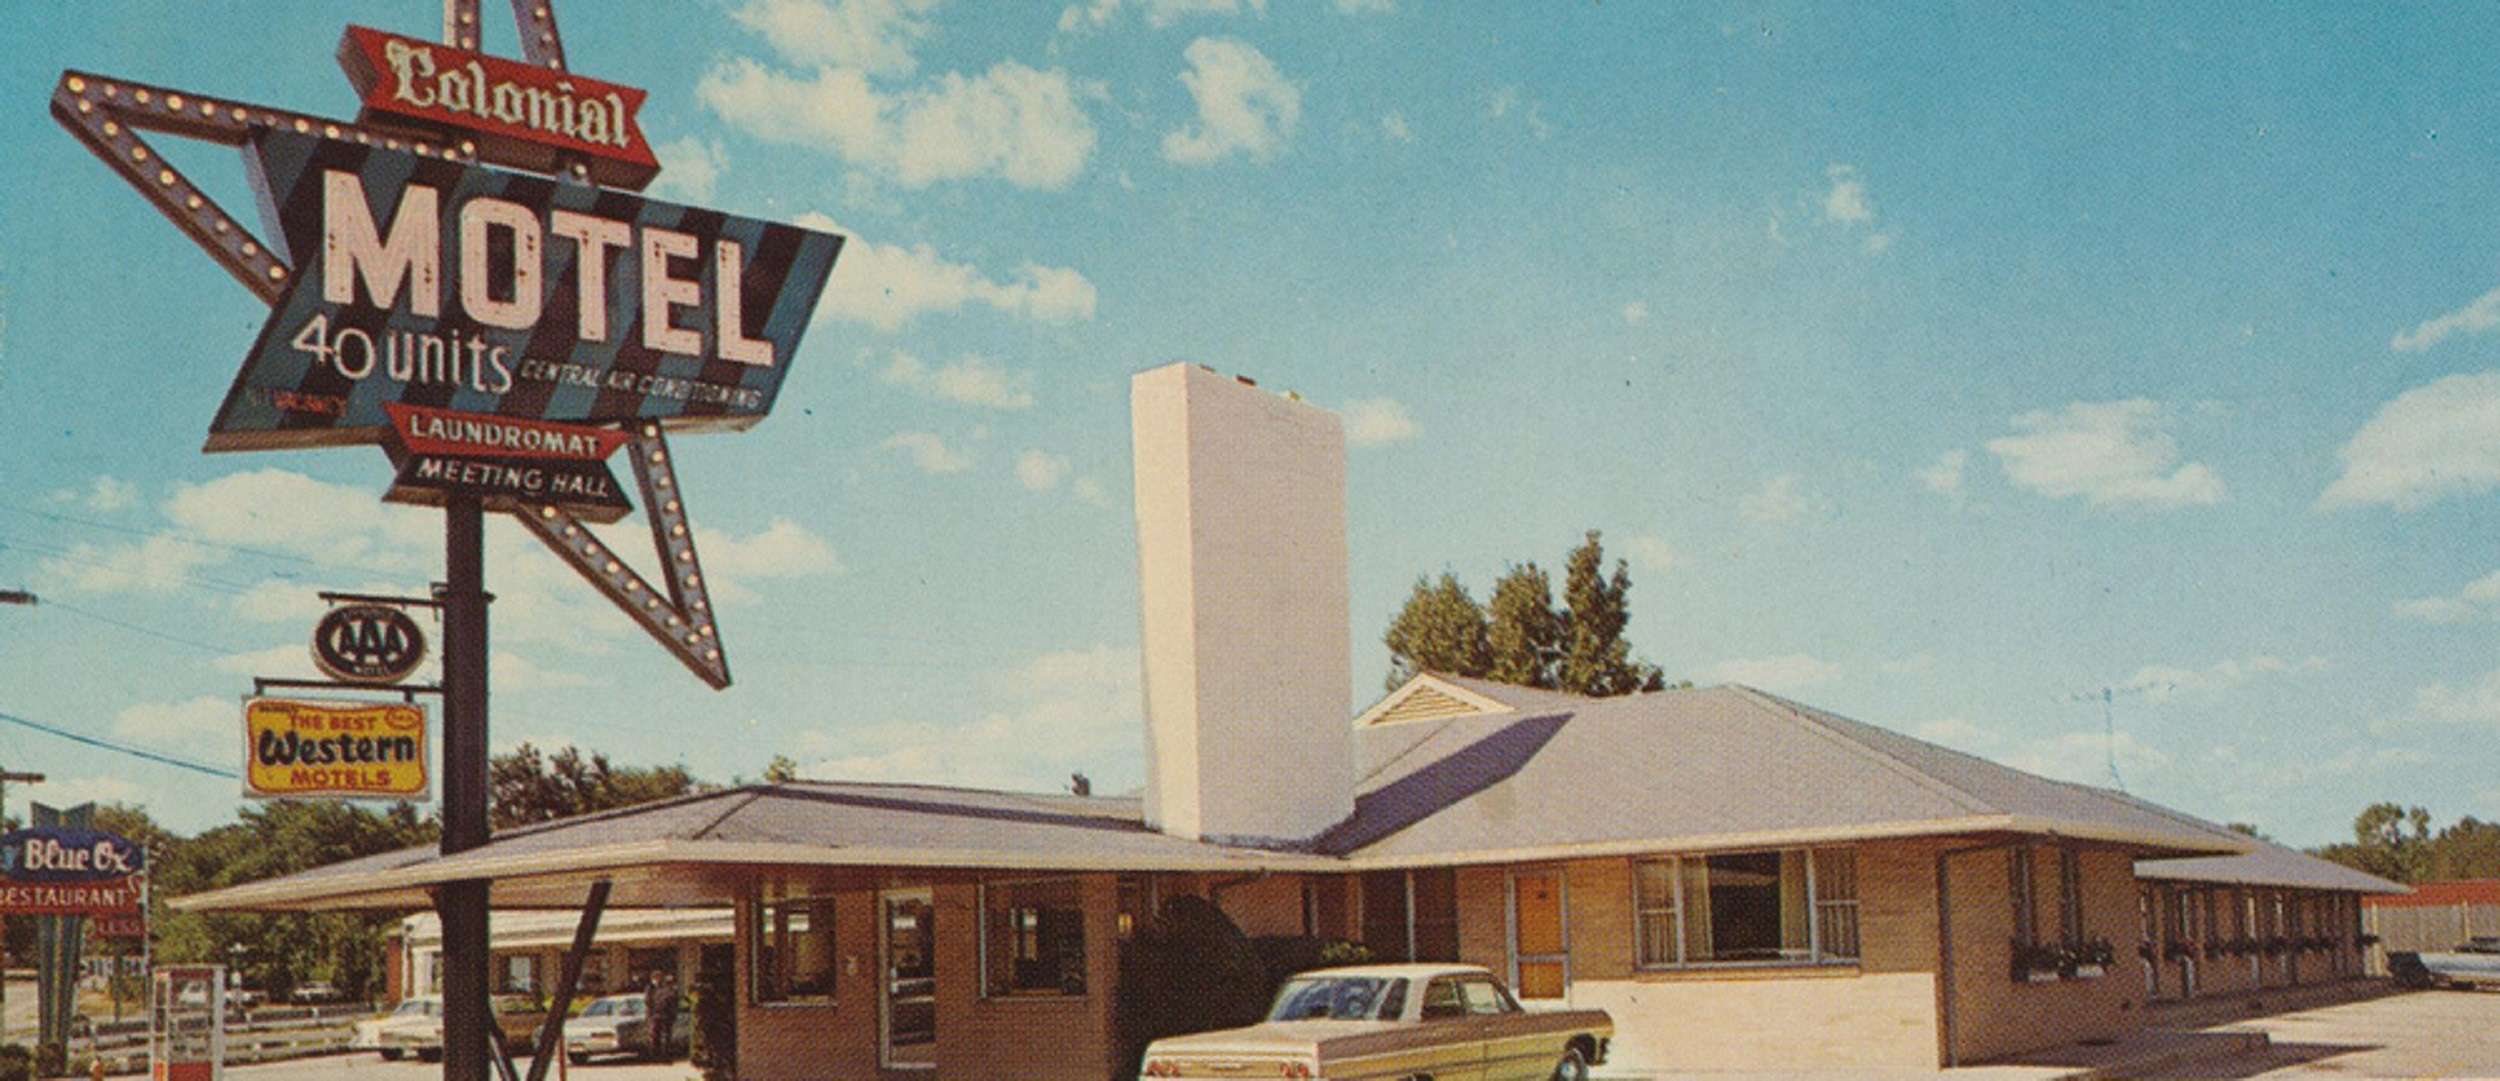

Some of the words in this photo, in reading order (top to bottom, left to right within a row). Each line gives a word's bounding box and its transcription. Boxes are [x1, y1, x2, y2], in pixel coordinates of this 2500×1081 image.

[385, 39, 630, 148] Colonial
[323, 168, 774, 367] MOTEL
[291, 313, 376, 380] 40
[387, 328, 512, 394] units
[520, 358, 599, 387] CENTRAL
[607, 369, 637, 391] AIR
[410, 413, 599, 456] LAUNDROMAT
[416, 457, 543, 490] MEETING
[551, 473, 609, 498] HALL
[338, 619, 405, 664] AAA
[289, 709, 322, 729] THE
[330, 714, 378, 730] BEST
[258, 728, 415, 765] Western
[290, 768, 392, 787] MOTELS
[24, 837, 90, 871] Blue
[93, 840, 133, 874] Ox
